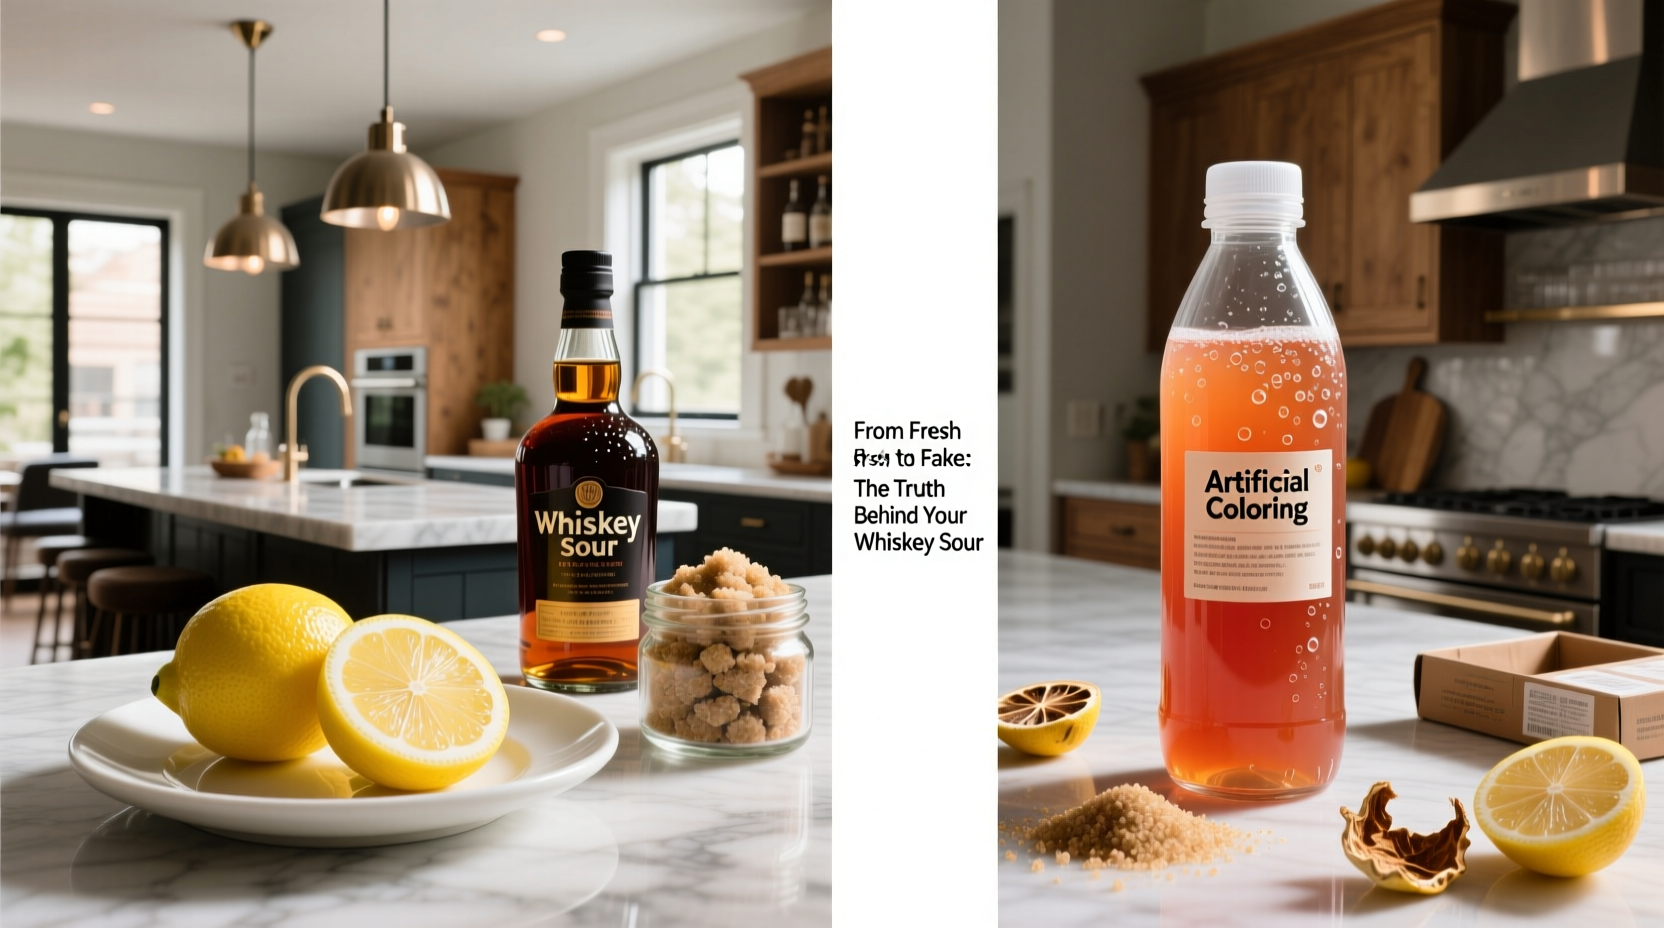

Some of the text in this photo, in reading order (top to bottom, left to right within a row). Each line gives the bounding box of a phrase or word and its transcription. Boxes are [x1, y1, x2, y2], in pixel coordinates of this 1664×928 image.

[1204, 467, 1309, 494] Artificial
[1205, 495, 1309, 526] Coloring
[534, 510, 642, 543] Whiskey
[560, 537, 619, 557] Sour
